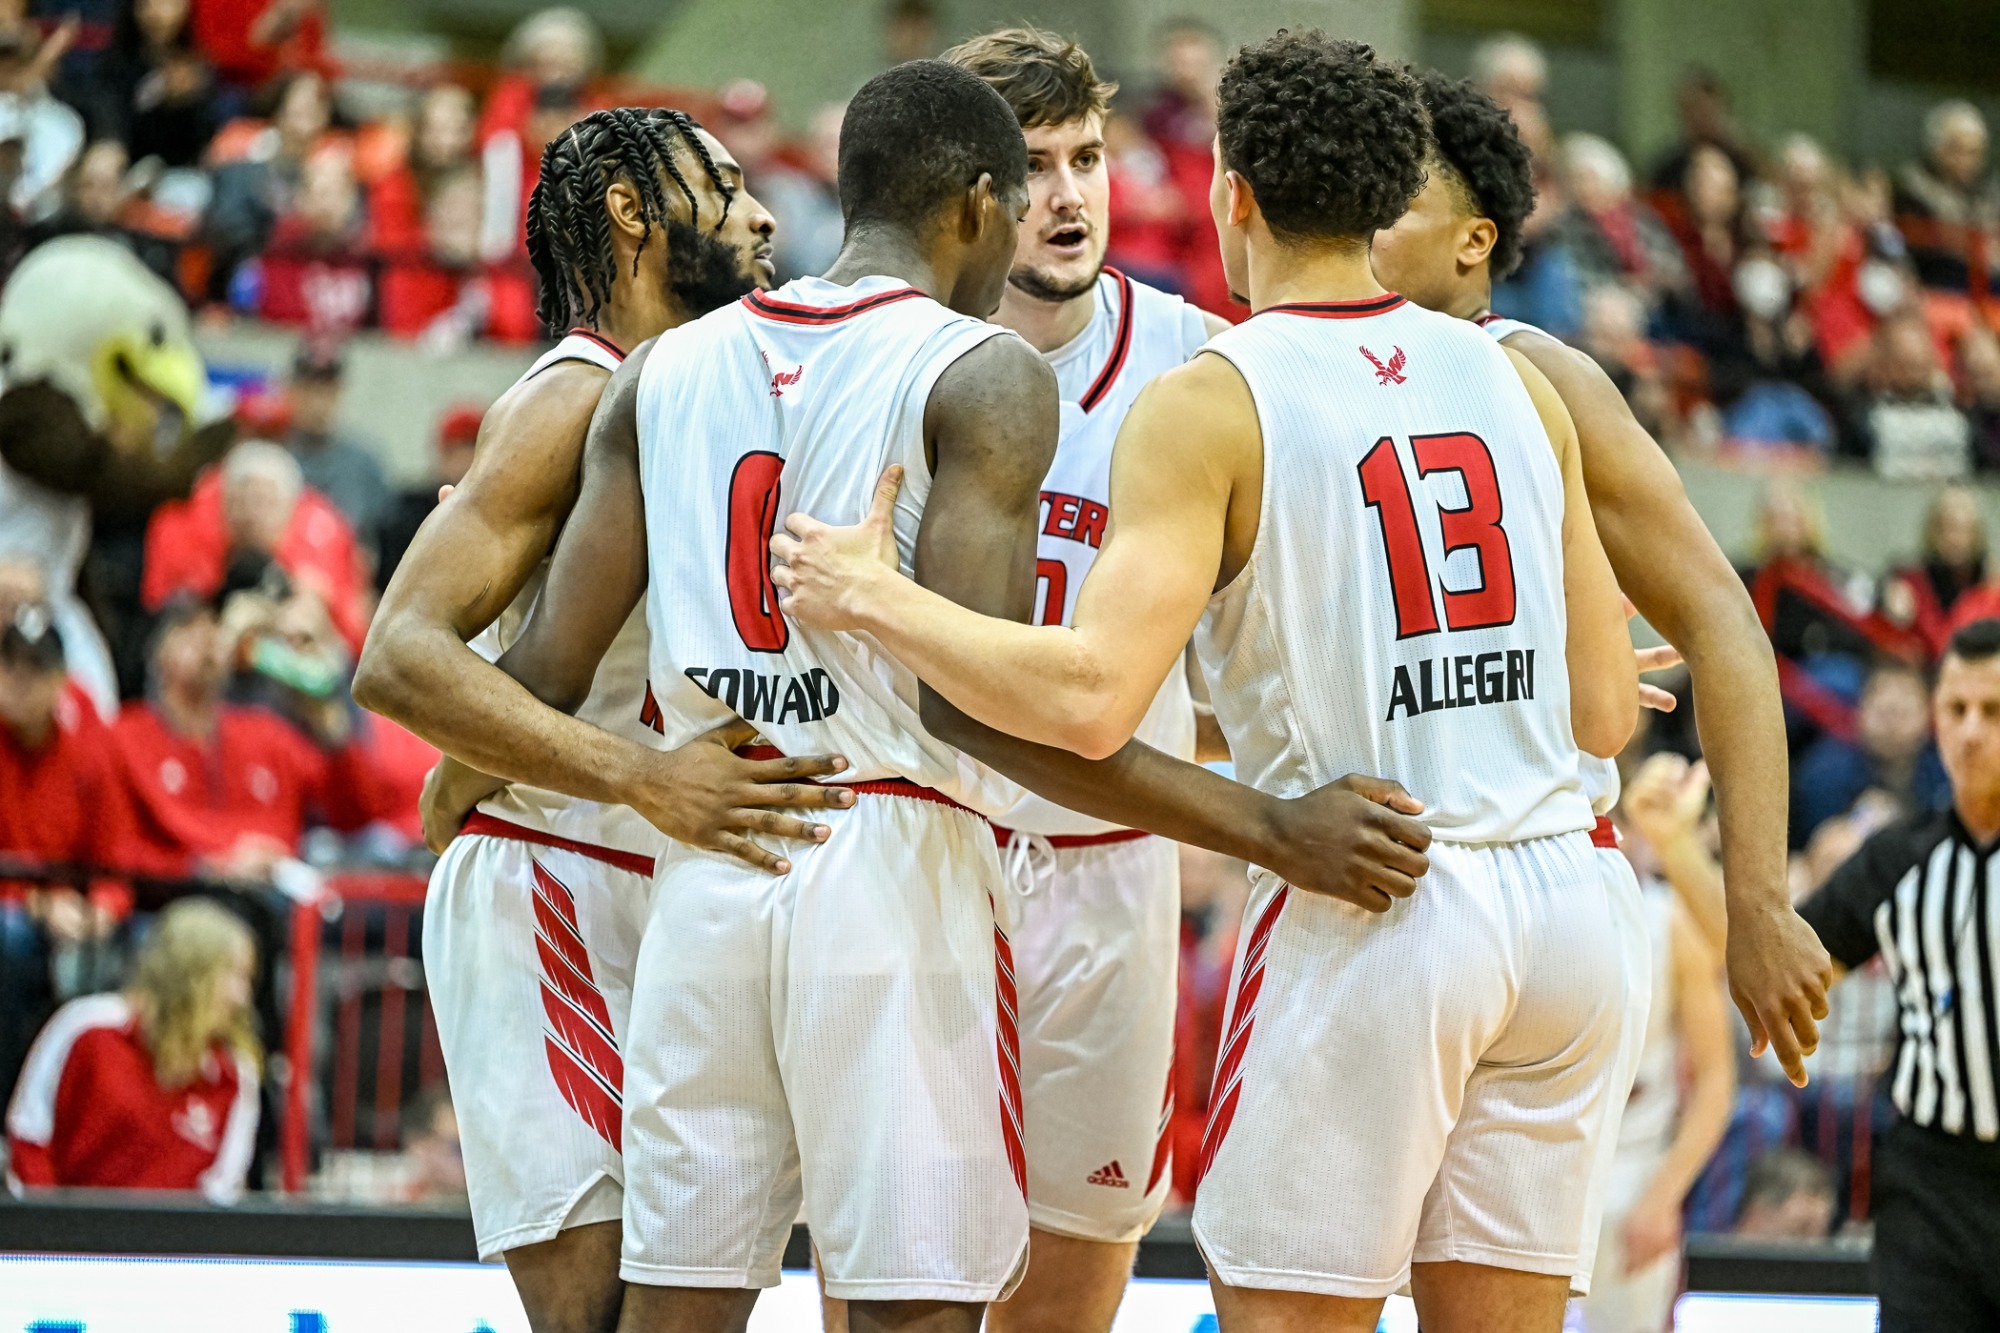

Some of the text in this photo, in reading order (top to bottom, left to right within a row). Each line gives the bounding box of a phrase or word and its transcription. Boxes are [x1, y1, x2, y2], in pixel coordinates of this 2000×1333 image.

[1357, 431, 1517, 641] 13
[1386, 649, 1535, 722] ALLEGRI
[1086, 1175, 1130, 1189] adidas
